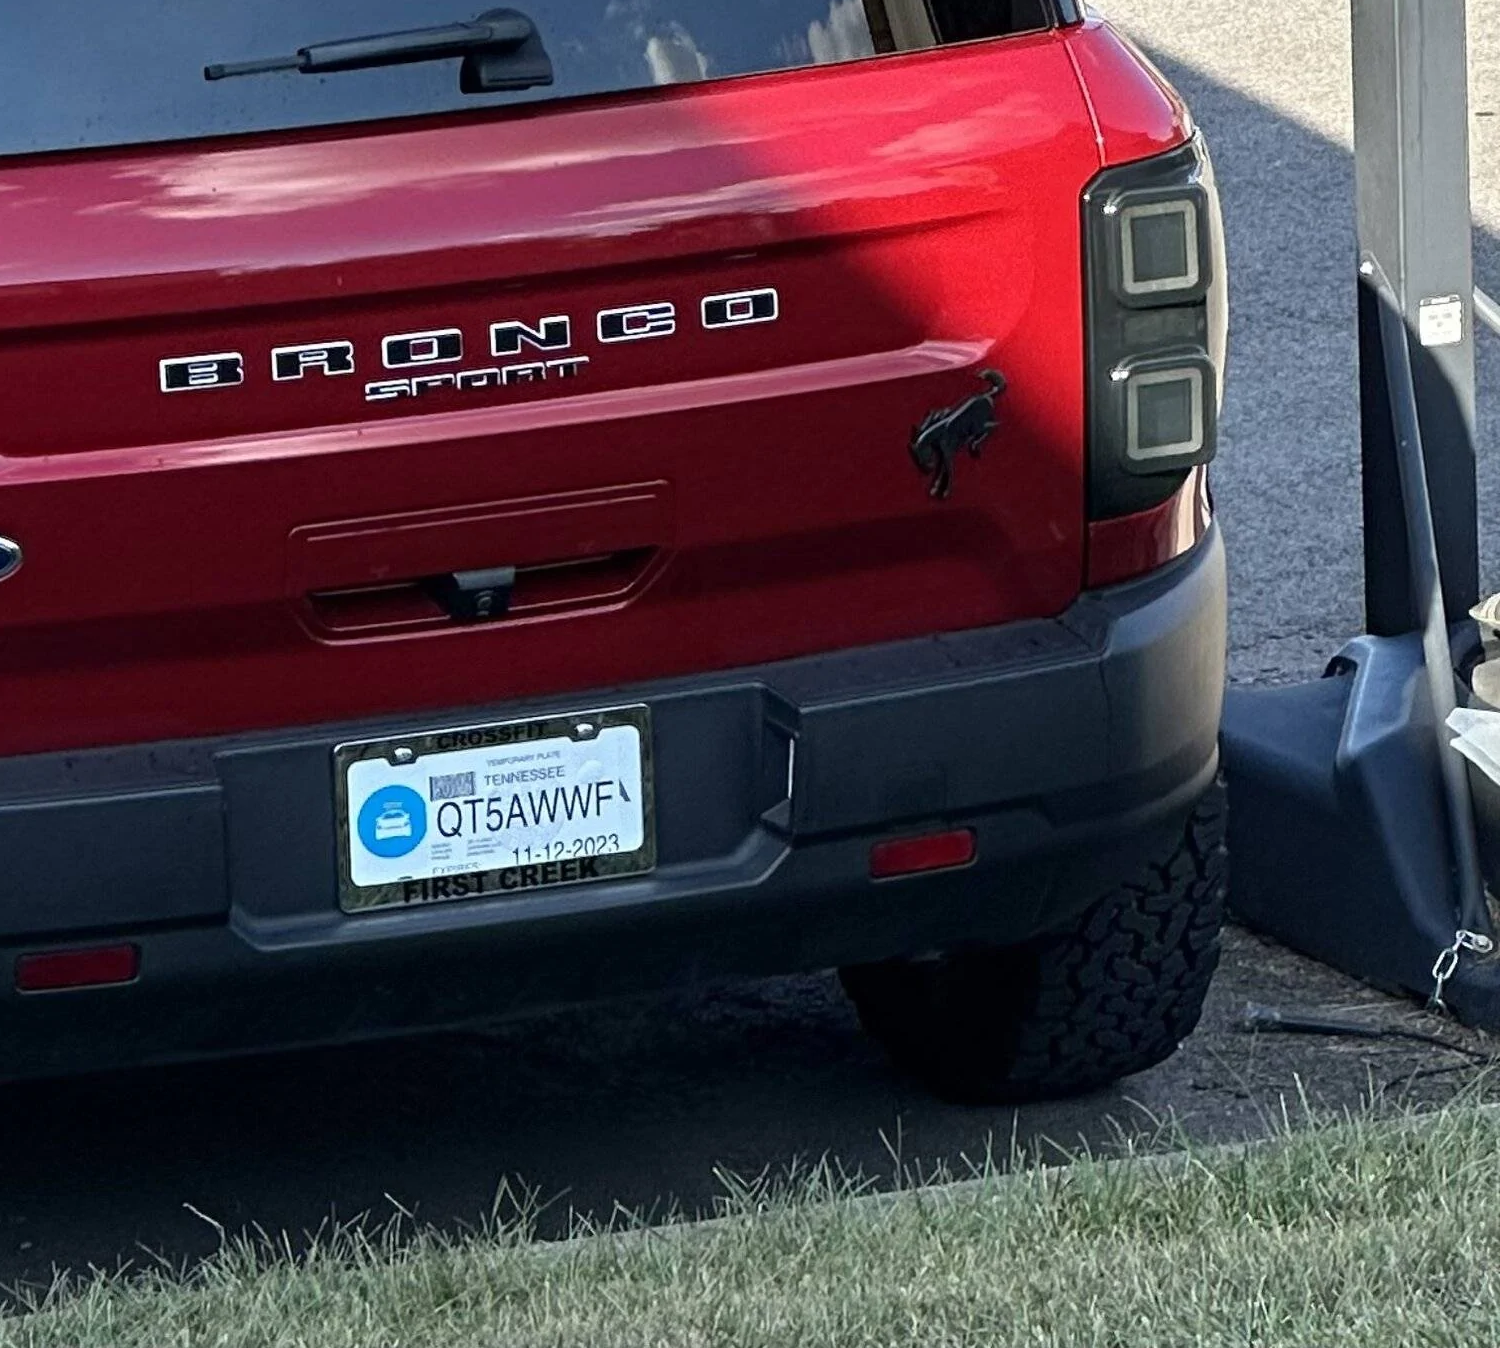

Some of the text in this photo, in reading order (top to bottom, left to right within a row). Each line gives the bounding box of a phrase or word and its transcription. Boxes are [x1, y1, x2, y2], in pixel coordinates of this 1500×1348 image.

[159, 288, 778, 392] BRONCO
[365, 356, 589, 401] SPORT
[437, 722, 548, 749] CROSSFIT
[484, 765, 565, 786] TENNESSEE
[512, 833, 619, 865] 11-12-2023
[404, 855, 599, 903] FIRST CREEK
